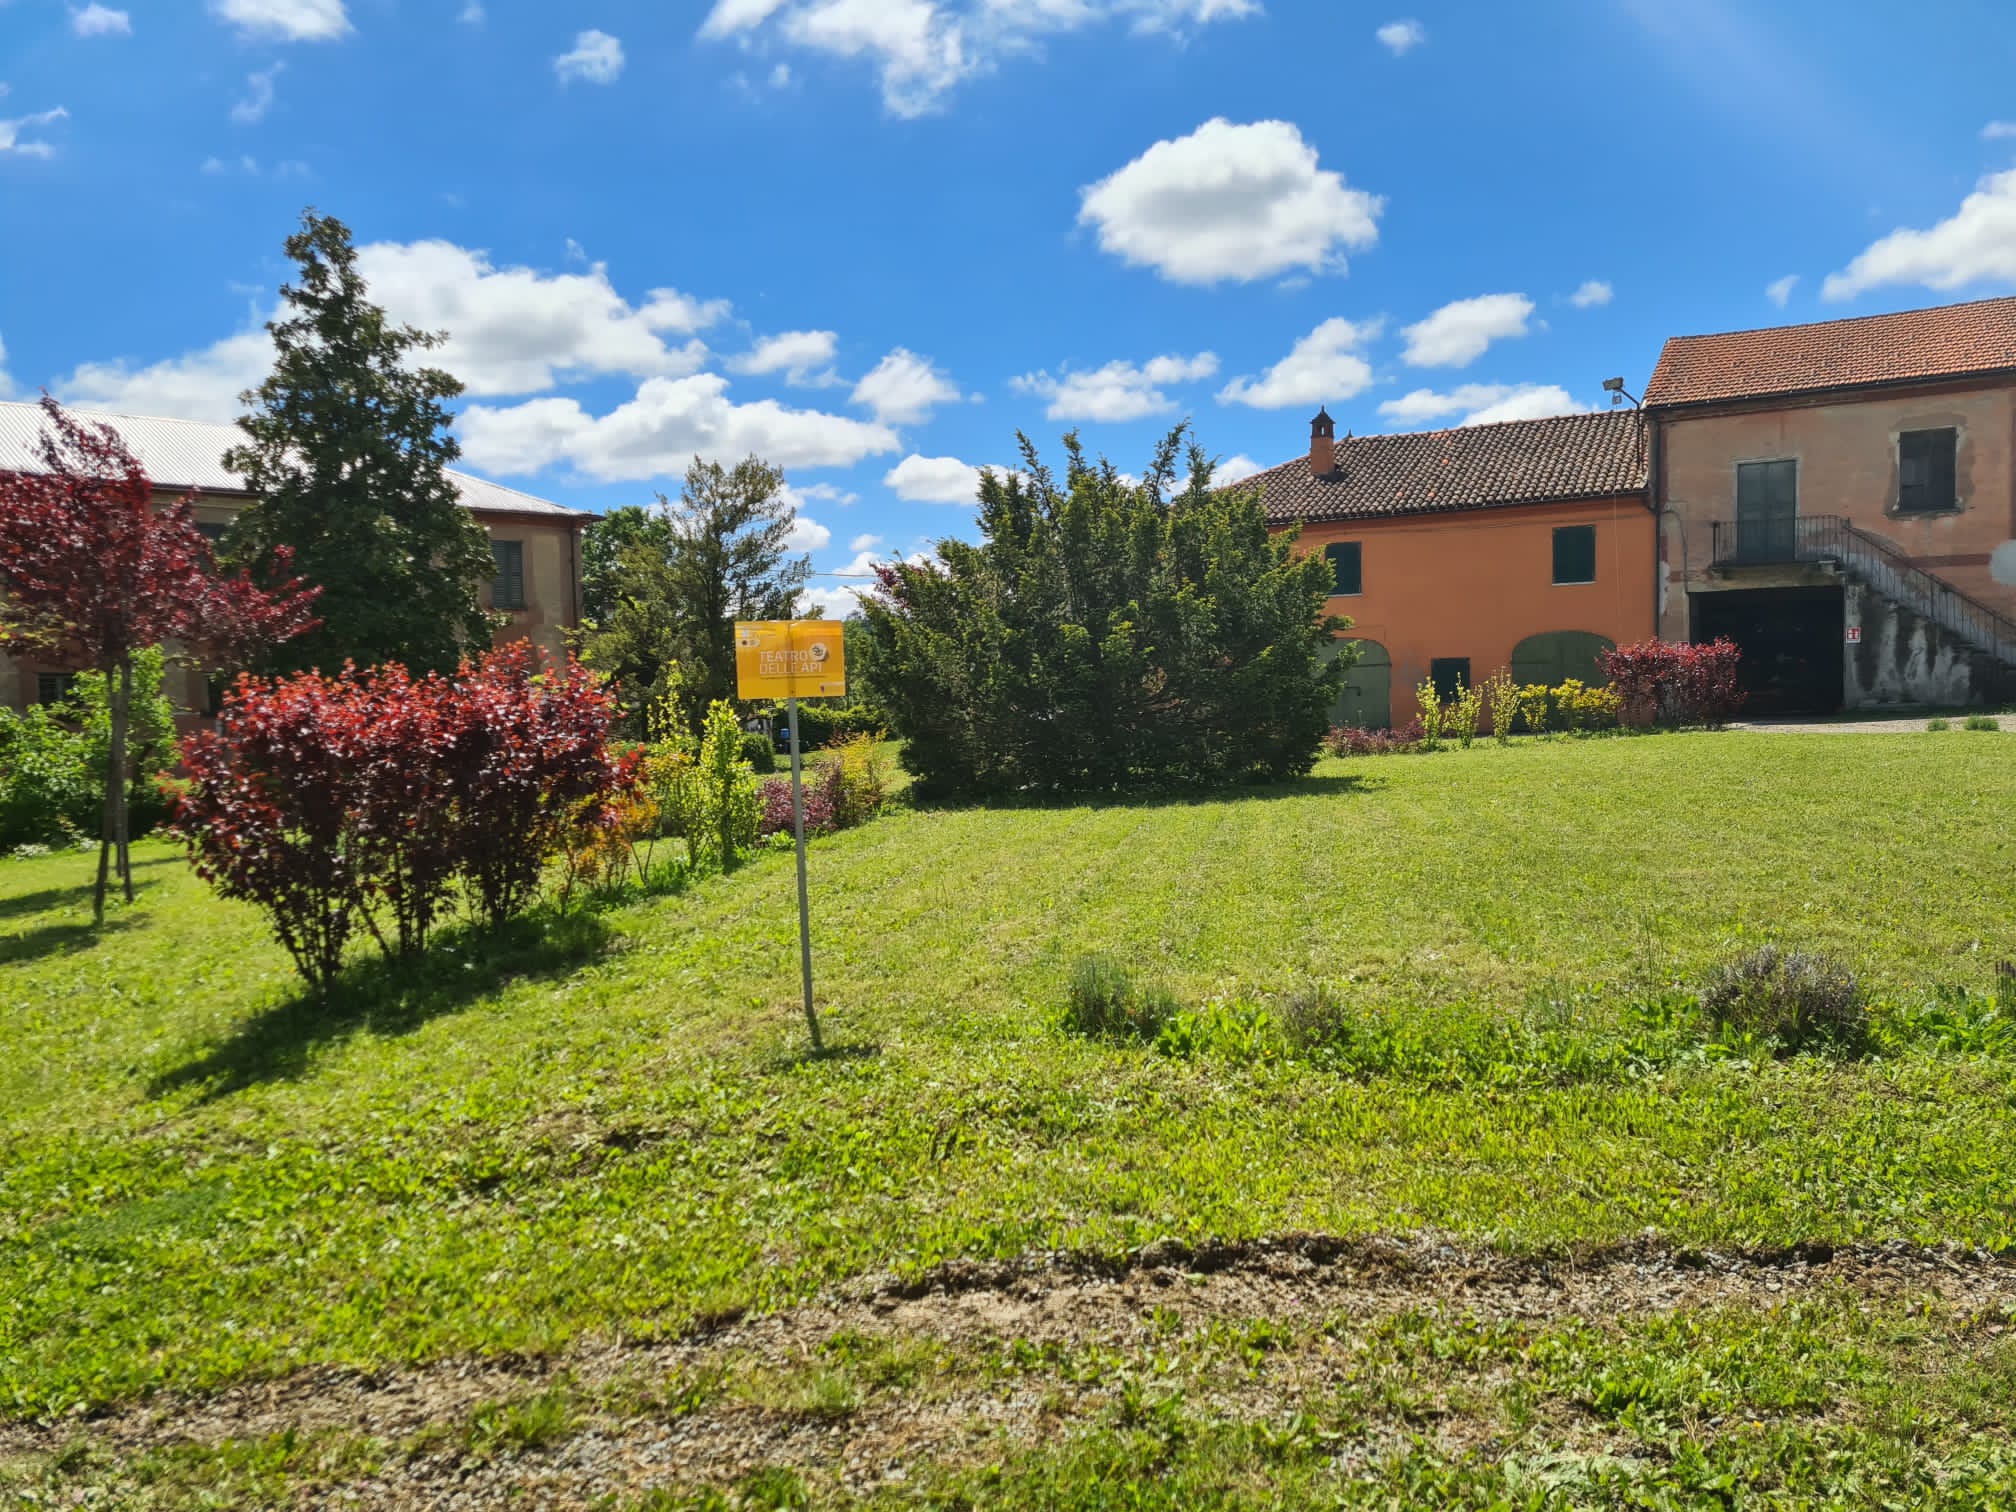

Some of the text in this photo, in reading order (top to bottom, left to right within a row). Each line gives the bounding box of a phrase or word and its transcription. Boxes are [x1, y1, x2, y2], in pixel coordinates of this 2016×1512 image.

[760, 650, 808, 662] TEATRO
[759, 662, 823, 674] DELLE API
